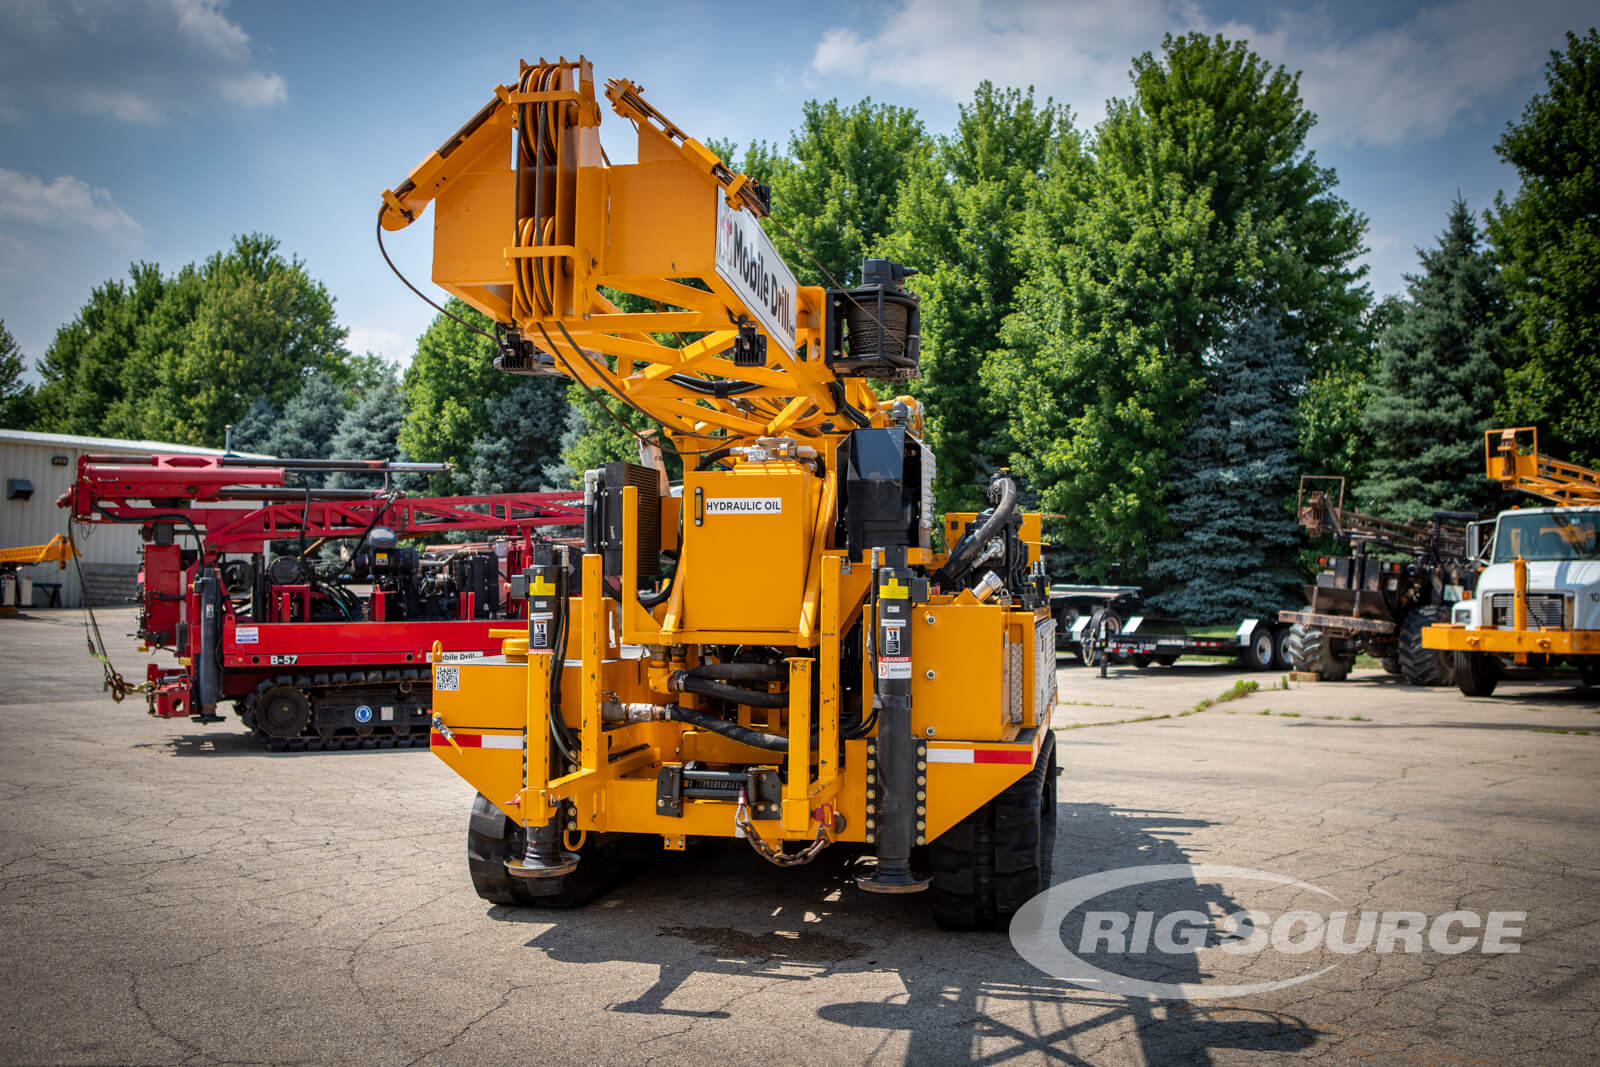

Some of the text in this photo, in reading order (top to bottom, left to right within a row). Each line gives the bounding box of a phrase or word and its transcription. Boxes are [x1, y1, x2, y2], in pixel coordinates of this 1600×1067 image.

[733, 222, 790, 335] Mobile Drill
[706, 501, 781, 511] HYDRAULIC OIL
[270, 655, 298, 665] B-57
